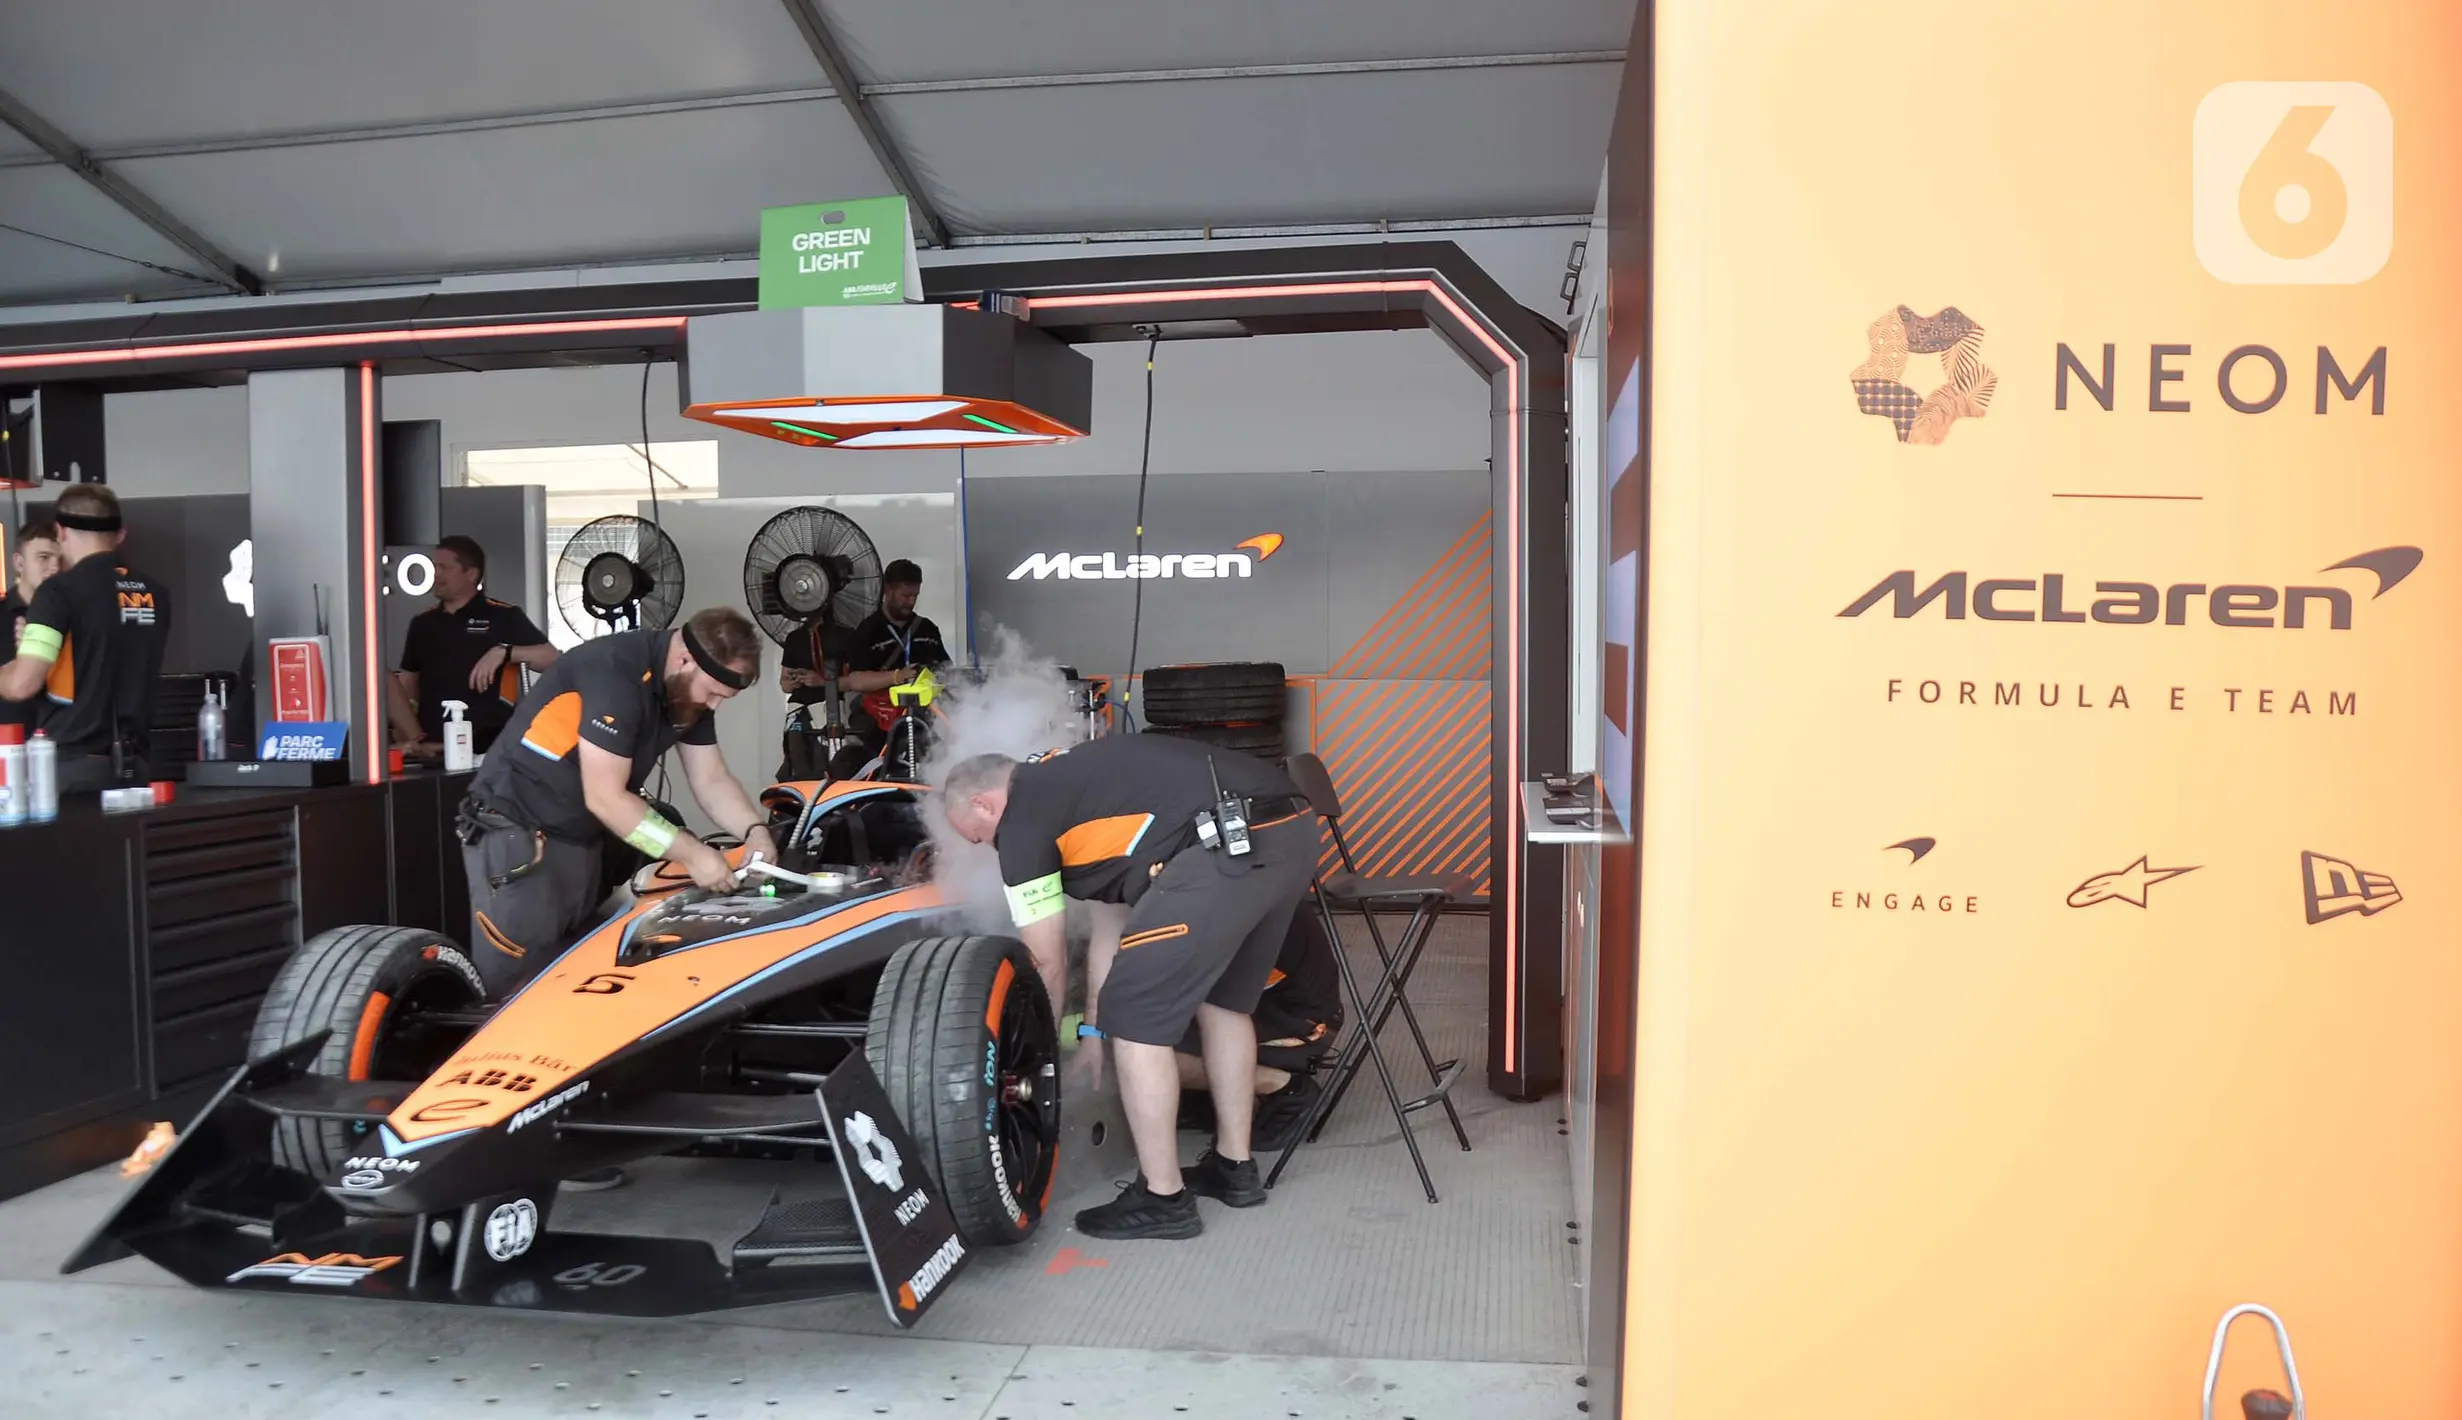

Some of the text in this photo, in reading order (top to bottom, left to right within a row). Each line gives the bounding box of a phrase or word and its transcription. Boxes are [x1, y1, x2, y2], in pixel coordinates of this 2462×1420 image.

[792, 227, 871, 251] GREEN
[799, 250, 864, 273] LIGHT
[2054, 342, 2388, 416] NEOM
[1006, 551, 1252, 580] McLaren
[1835, 569, 2353, 631] McLaren
[1887, 679, 2358, 717] FORMULA E TEAM
[276, 747, 337, 760] FERME
[279, 735, 325, 748] PARC
[1831, 891, 1979, 914] ENGAGE
[572, 973, 637, 995] 5
[435, 1069, 537, 1092] ABB
[507, 1080, 591, 1135] McLaren
[344, 1156, 421, 1173] NEOM
[893, 1187, 930, 1227] NEOM
[488, 1206, 534, 1255] FIA
